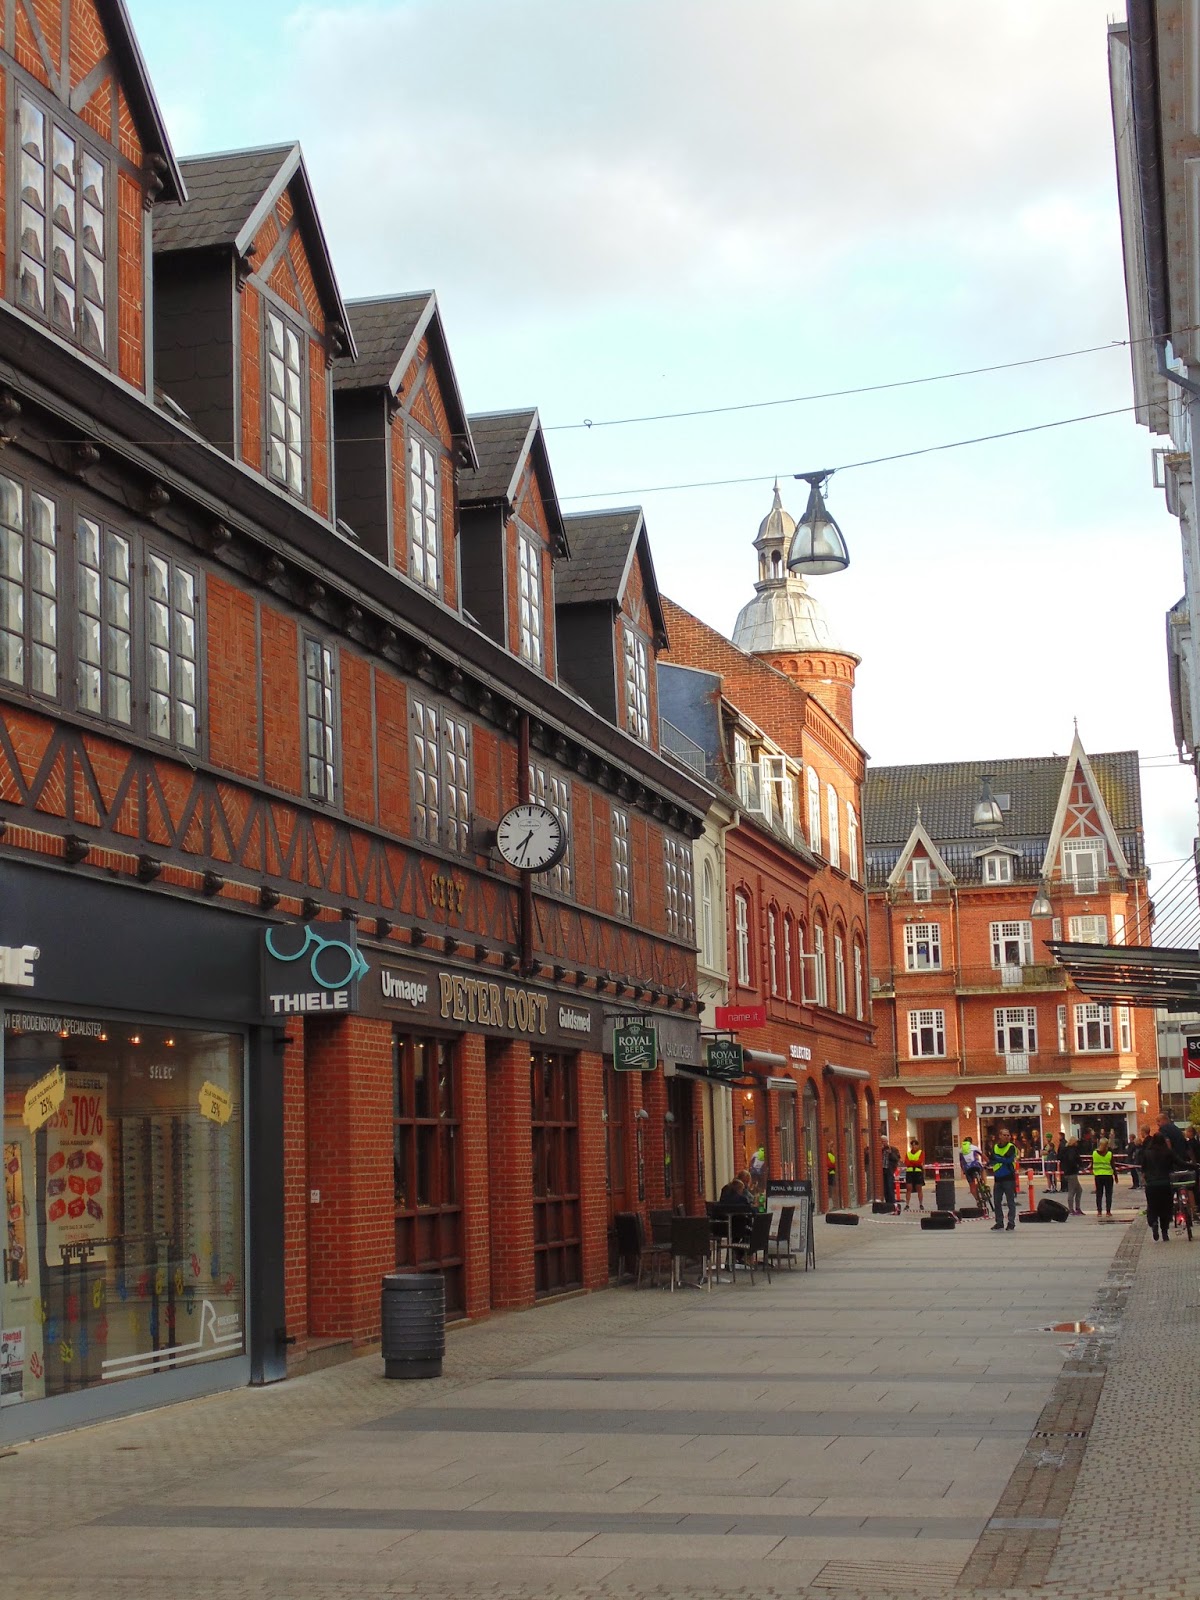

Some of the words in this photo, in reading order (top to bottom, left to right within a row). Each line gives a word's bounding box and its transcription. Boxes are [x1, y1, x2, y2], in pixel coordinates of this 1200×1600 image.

[381, 970, 428, 1007] Urmager
[270, 991, 349, 1013] THIELE
[439, 972, 504, 1028] PETER
[505, 986, 548, 1035] TOFT
[558, 1006, 591, 1033] Guldsmed
[728, 1013, 751, 1022] name
[618, 1036, 652, 1047] ROYAL
[625, 1045, 645, 1054] BEER
[711, 1050, 739, 1060] ROYAL
[40, 1095, 53, 1116] 25%
[980, 1104, 1037, 1115] DEGN
[1069, 1101, 1127, 1112] DEGN
[72, 1095, 103, 1136] 70%
